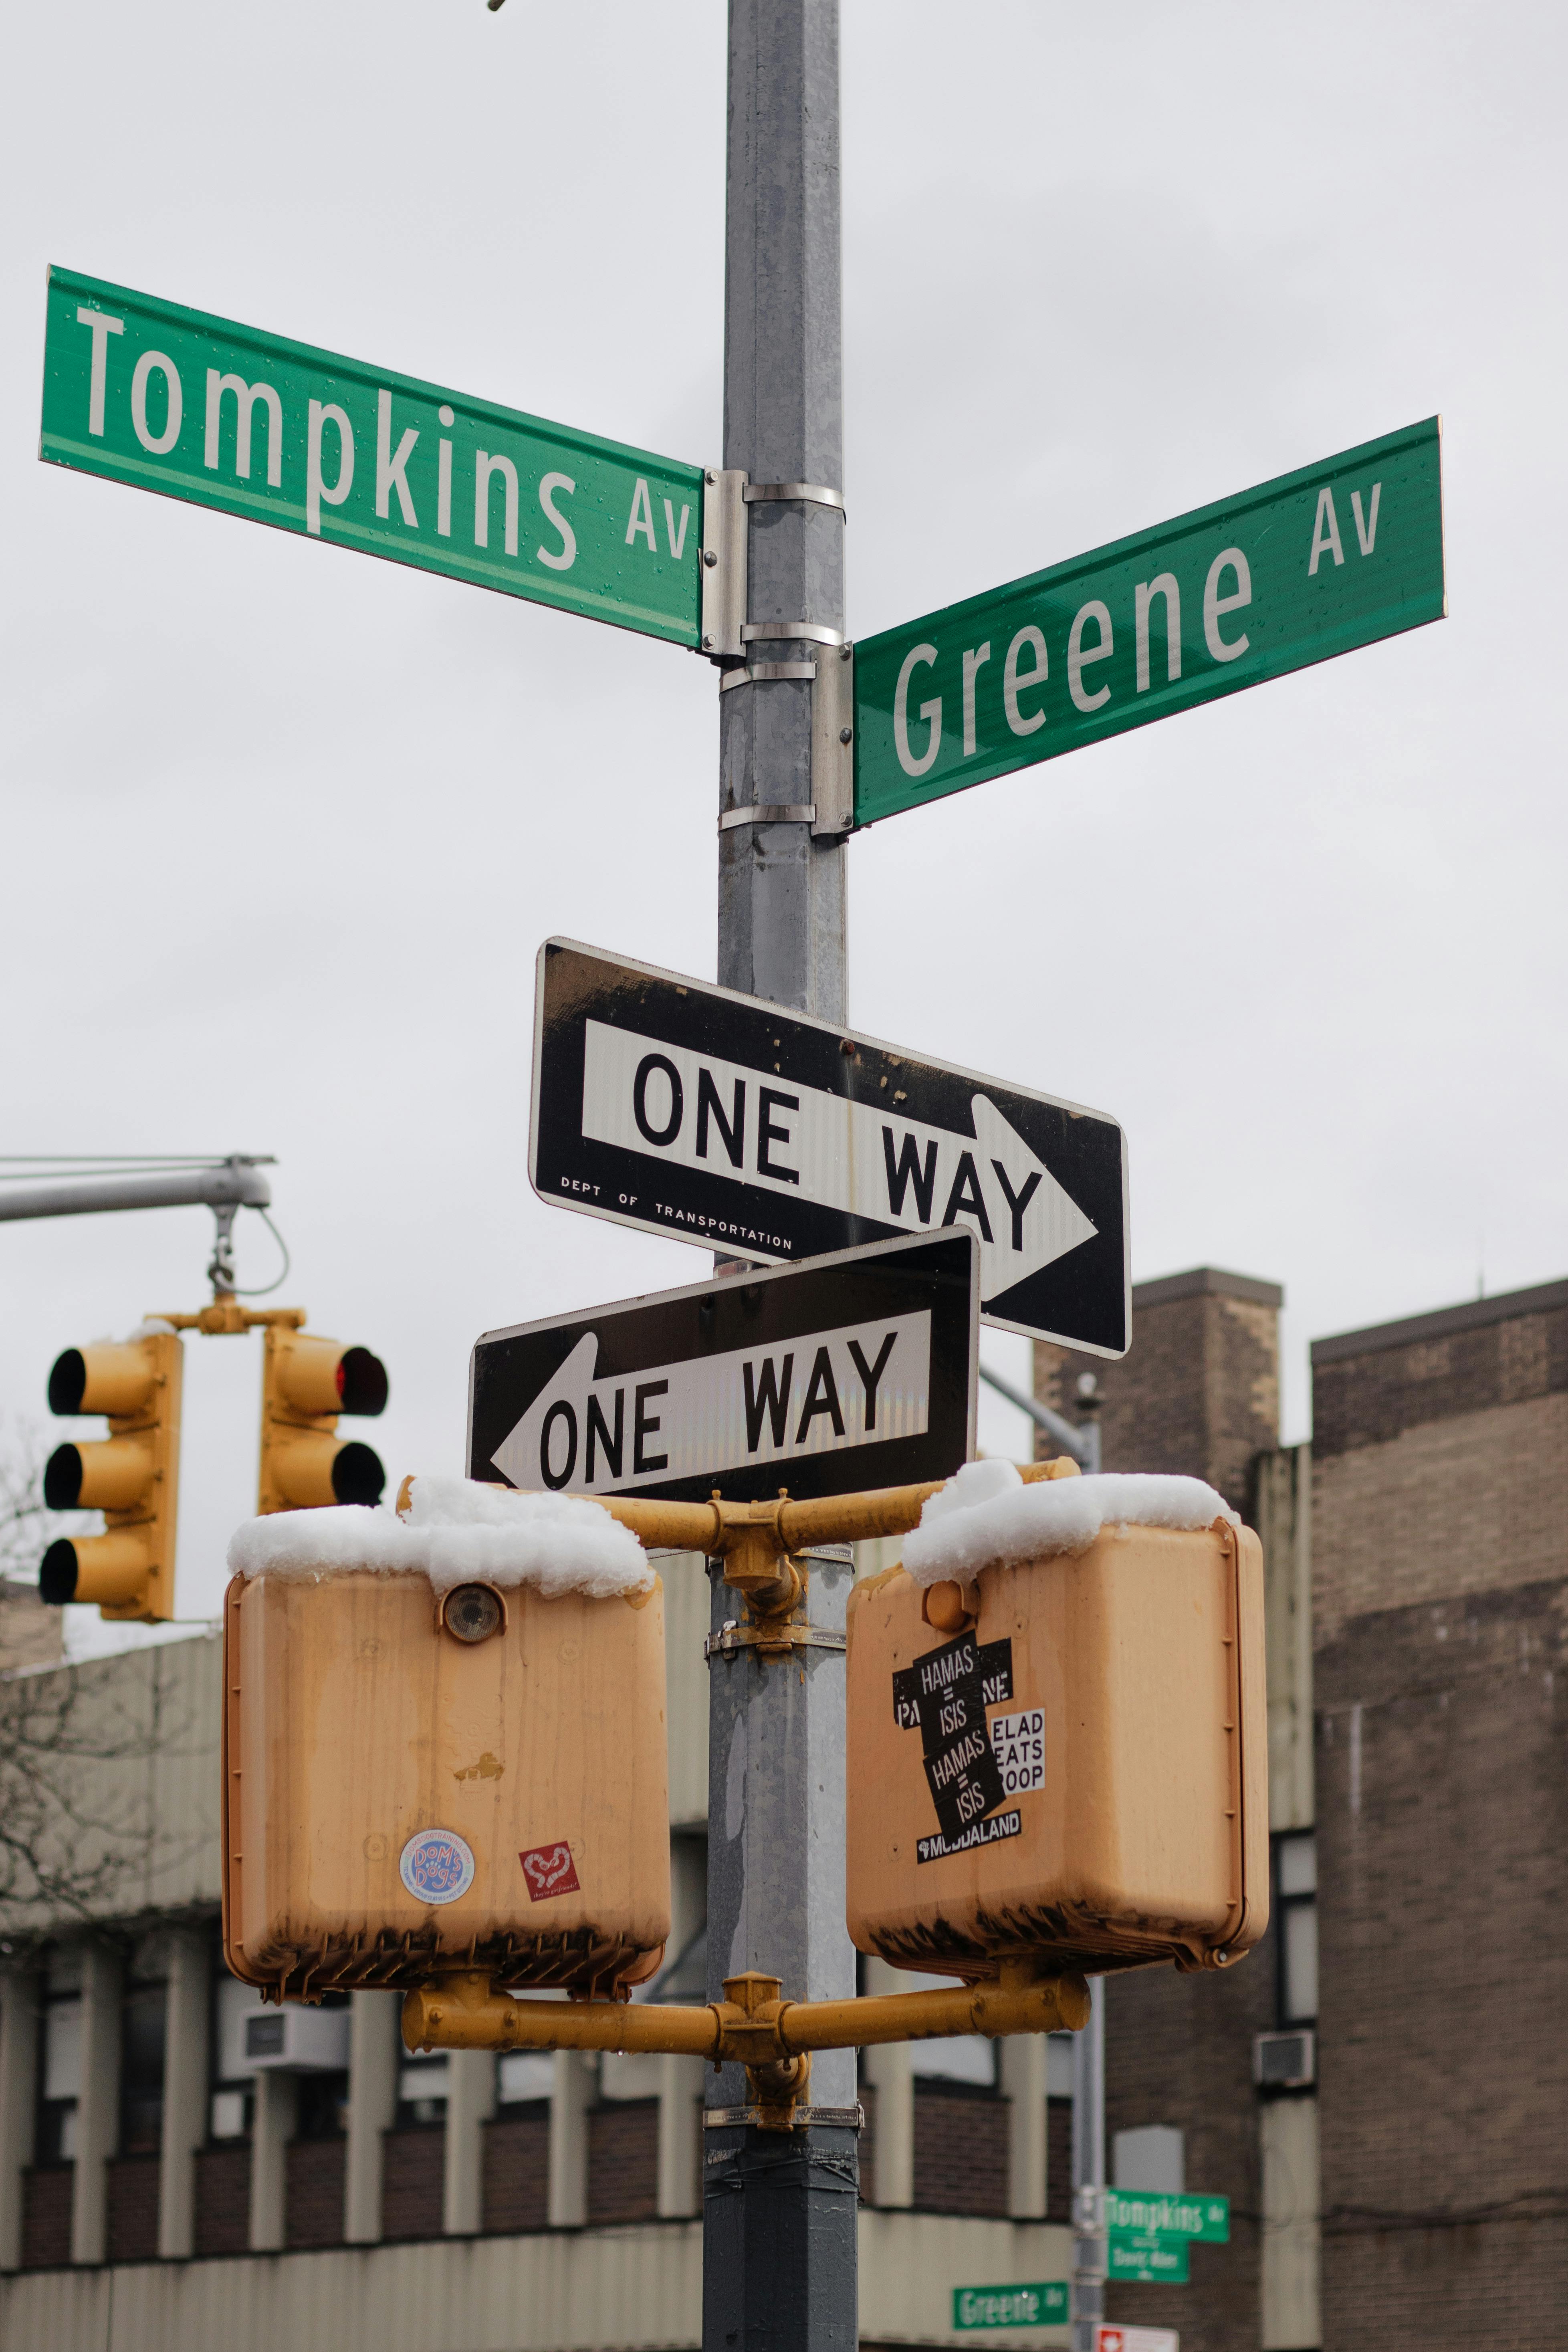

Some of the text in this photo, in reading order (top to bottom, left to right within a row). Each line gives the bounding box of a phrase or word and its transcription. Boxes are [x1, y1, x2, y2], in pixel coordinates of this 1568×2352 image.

[77, 307, 690, 571] Tompkins Av
[894, 482, 1382, 777] Greene Av
[634, 1053, 1043, 1252] ONE WAY
[561, 1177, 791, 1250] DEPT OF TRANSPORTATION
[541, 1331, 898, 1490] ONE WAY
[922, 1645, 973, 1695] HAMAS
[940, 1700, 967, 1736] ISIS
[993, 1713, 1043, 1742] ELAD
[932, 1729, 985, 1790] HAMAS
[999, 1765, 1042, 1791] OOP
[956, 1782, 985, 1823] ISIS
[406, 1833, 471, 1864] DOMSDOGTRAINING.COM
[414, 1888, 428, 1899] GROUP
[458, 1877, 469, 1894] SITTING
[534, 1890, 550, 1898] they're
[961, 2291, 1039, 2326] Greene
